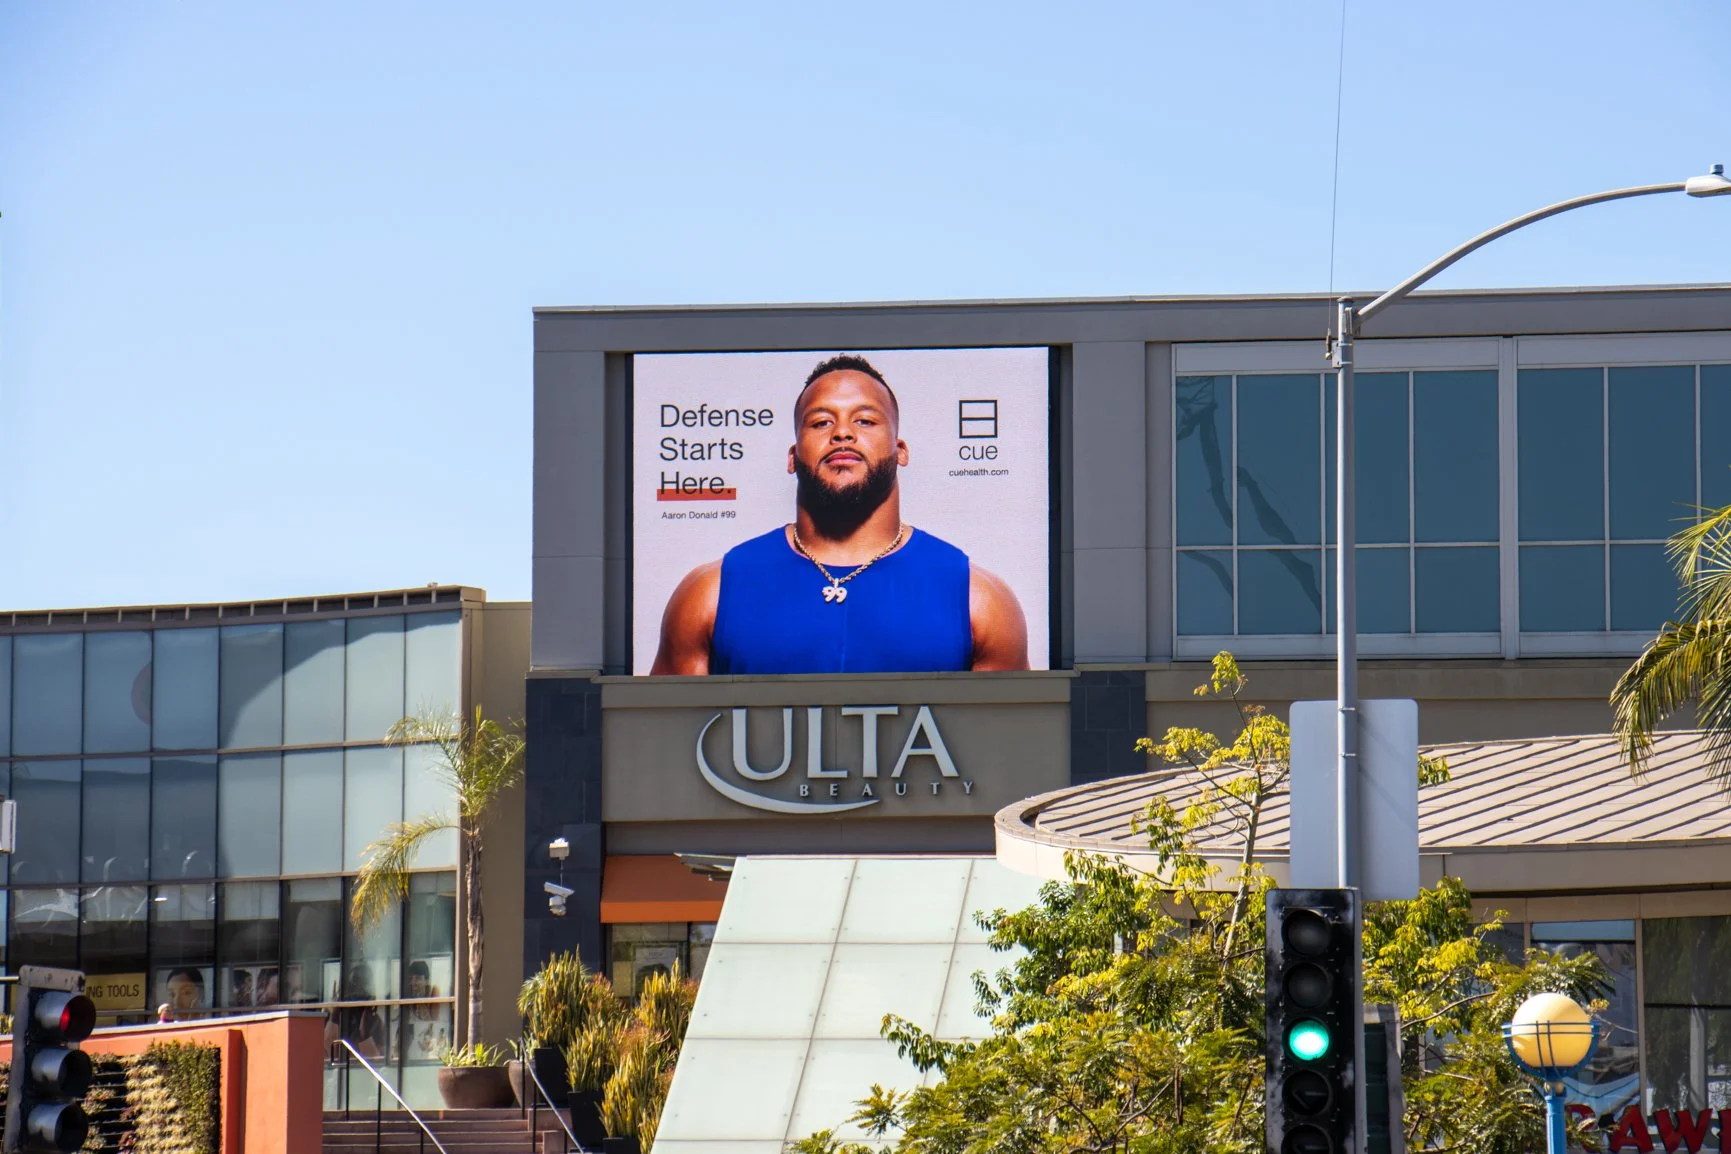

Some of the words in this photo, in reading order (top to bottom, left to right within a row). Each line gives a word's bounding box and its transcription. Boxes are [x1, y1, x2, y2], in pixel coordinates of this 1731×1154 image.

[660, 403, 774, 428] Defense
[659, 436, 744, 462] Starts
[958, 444, 998, 461] cue
[948, 468, 1009, 477] cuehealth.com
[660, 471, 732, 495] Here.
[661, 511, 687, 520] Aaron
[688, 511, 718, 519] Donald
[720, 510, 736, 519] #99
[732, 705, 960, 781] ULTA
[799, 781, 975, 798] BEAUTY
[107, 984, 140, 998] TOOLS
